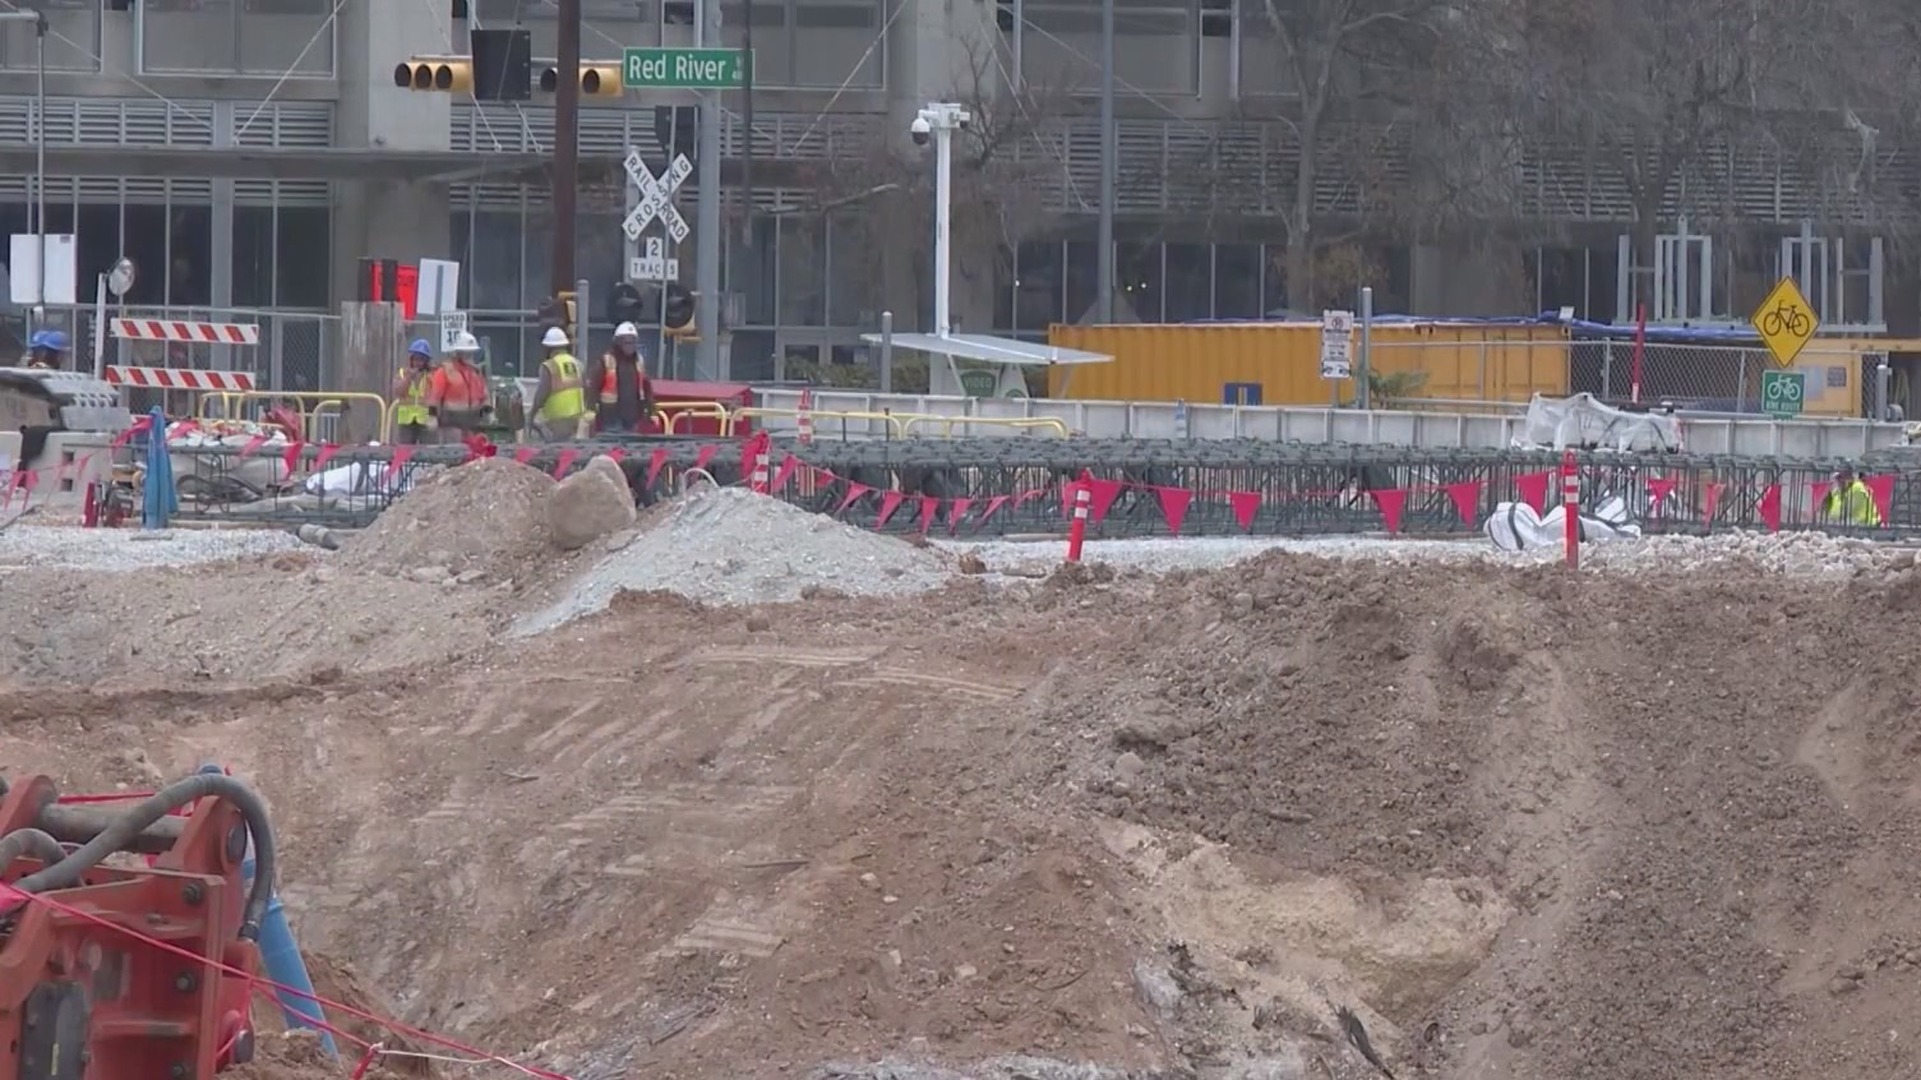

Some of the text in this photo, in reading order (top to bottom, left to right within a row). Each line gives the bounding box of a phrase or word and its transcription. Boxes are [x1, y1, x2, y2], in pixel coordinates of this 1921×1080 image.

[629, 53, 667, 80] Red
[676, 52, 727, 81] River
[650, 243, 659, 257] 2
[633, 262, 675, 275] TRACS
[964, 376, 993, 389] VIDEO
